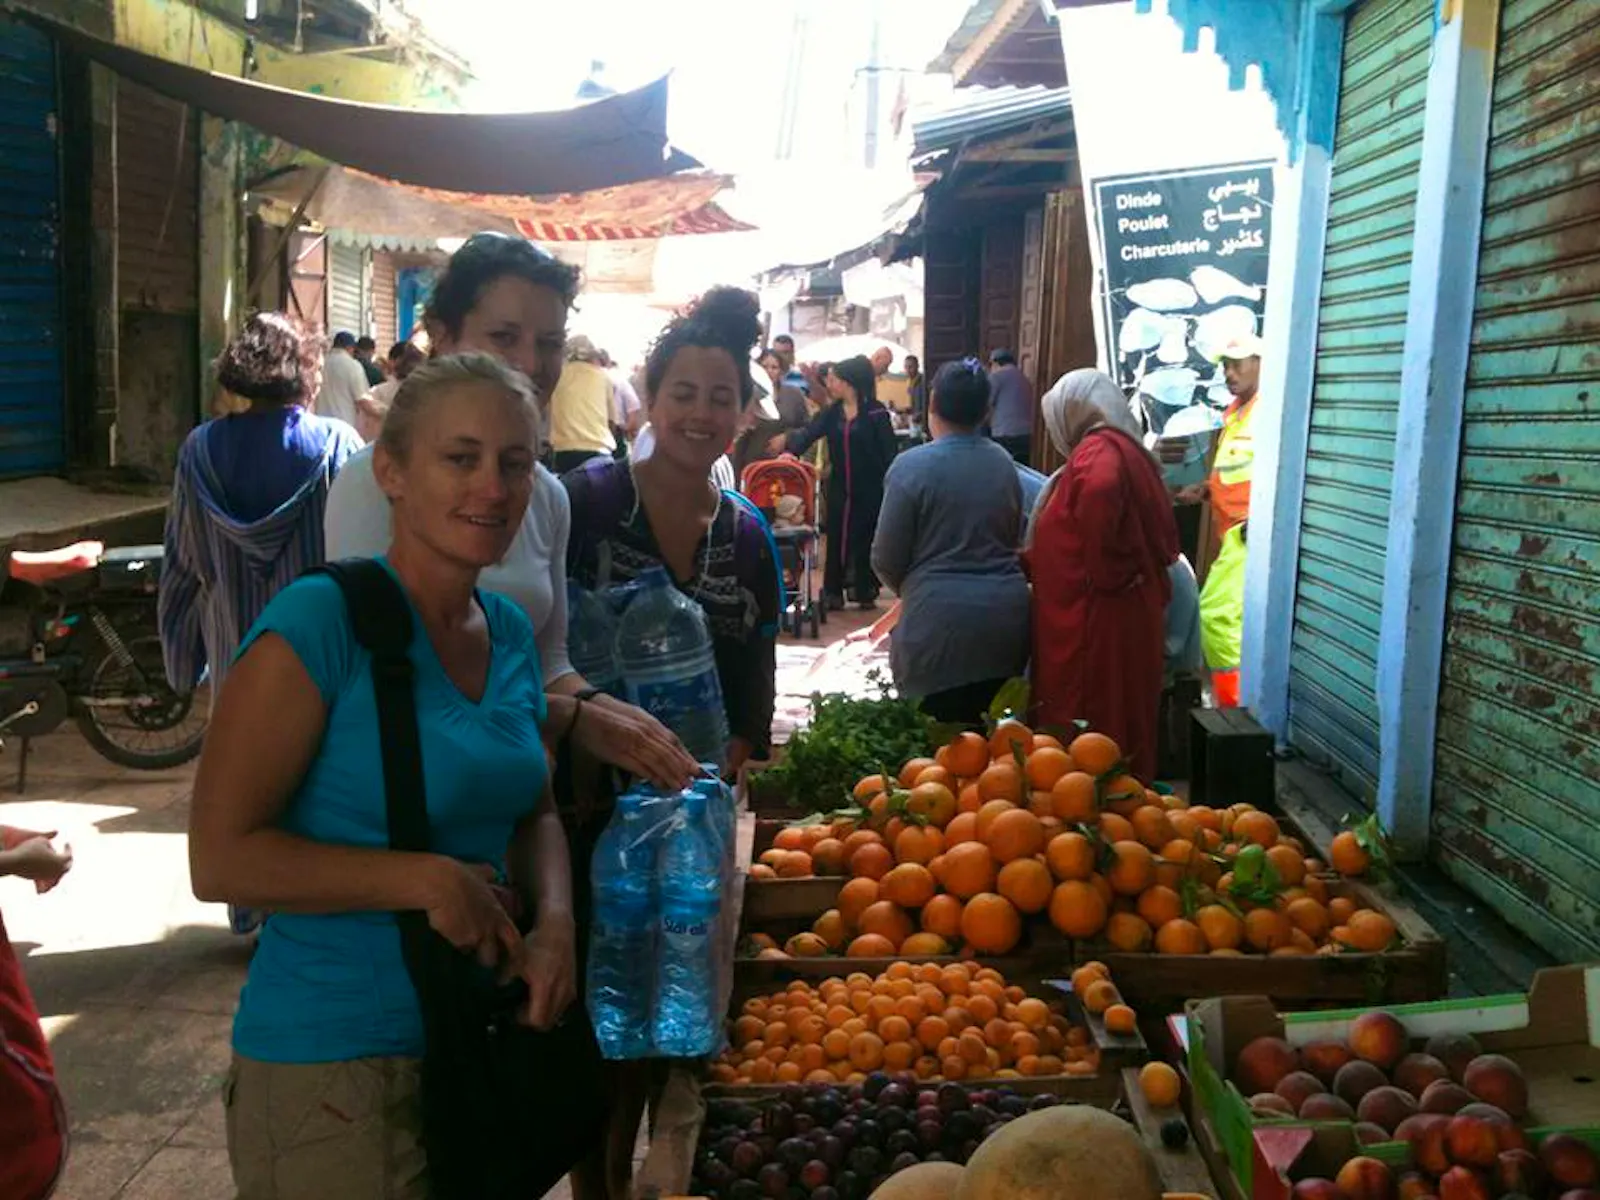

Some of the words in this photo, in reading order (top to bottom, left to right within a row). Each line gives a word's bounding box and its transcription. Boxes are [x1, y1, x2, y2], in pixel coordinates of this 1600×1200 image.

[1115, 191, 1162, 210] Dinde
[1117, 213, 1170, 234] Poulet
[1202, 203, 1262, 232] دجاج
[1120, 237, 1211, 261] Charcuterie
